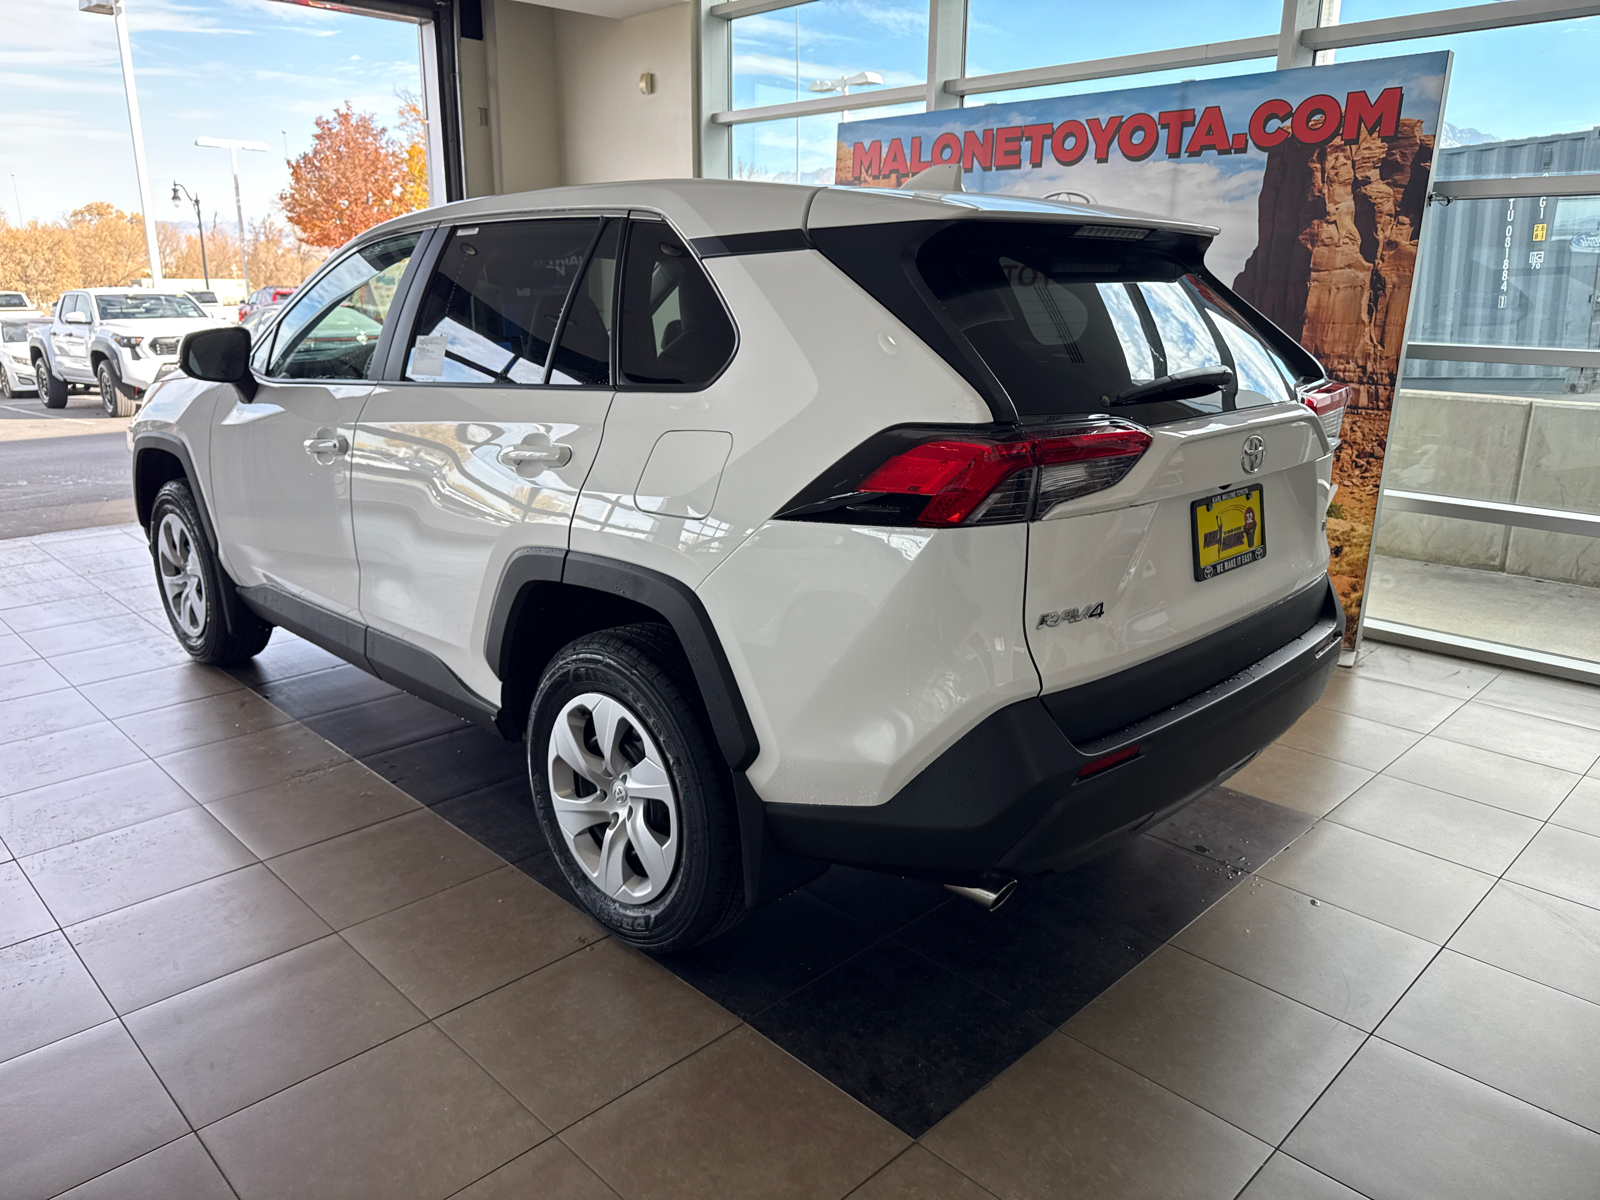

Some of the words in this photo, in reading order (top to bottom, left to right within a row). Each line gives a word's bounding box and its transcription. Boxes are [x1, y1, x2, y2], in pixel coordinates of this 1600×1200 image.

[851, 86, 1404, 180] MALONETOYOTA.COM
[1501, 225, 1513, 292] 081884
[1246, 512, 1253, 523] 32
[1216, 563, 1223, 573] WE
[1224, 558, 1236, 571] MAKE
[1241, 552, 1252, 564] EASY
[1036, 601, 1104, 630] RAV4
